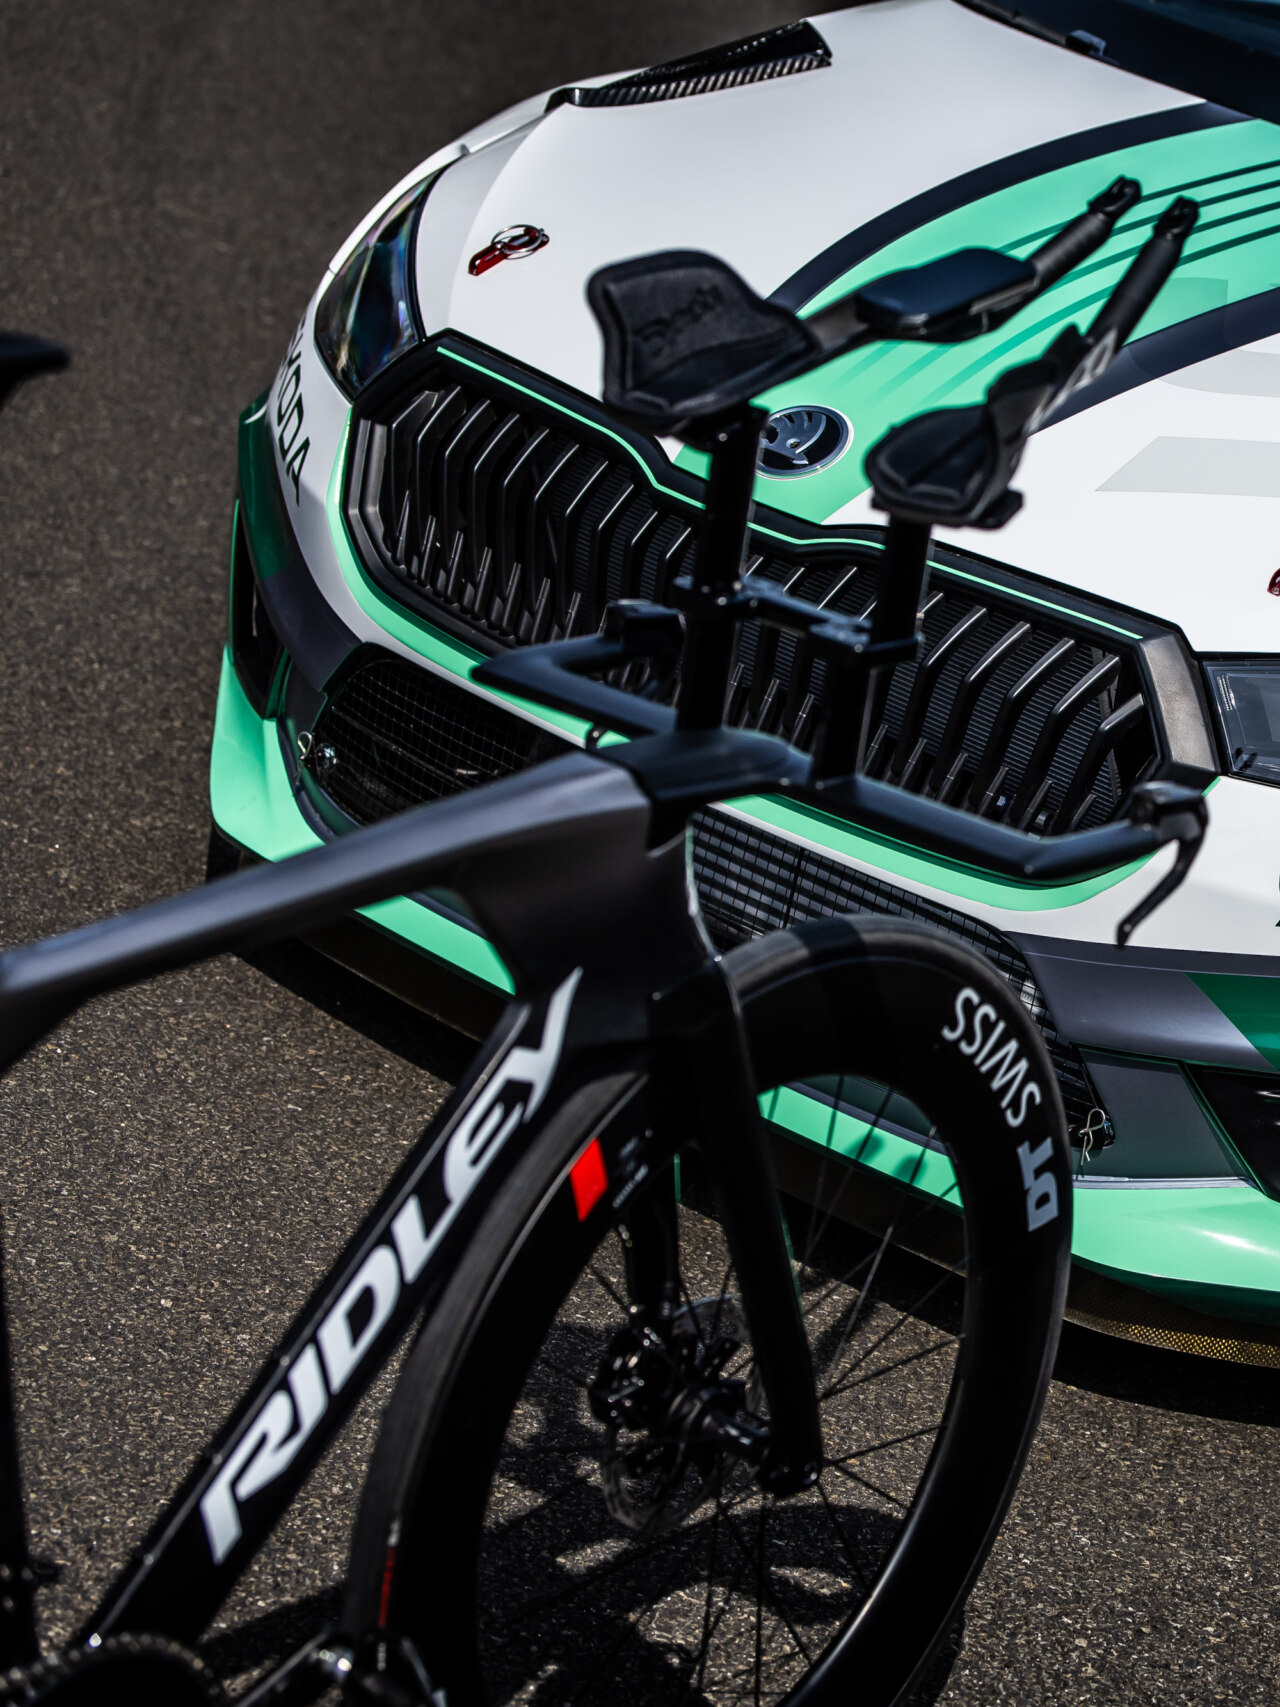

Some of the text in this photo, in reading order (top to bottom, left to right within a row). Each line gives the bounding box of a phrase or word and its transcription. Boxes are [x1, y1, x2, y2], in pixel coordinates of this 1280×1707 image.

[200, 966, 584, 1566] RIDLEY
[940, 986, 1060, 1233] DT SWISS
